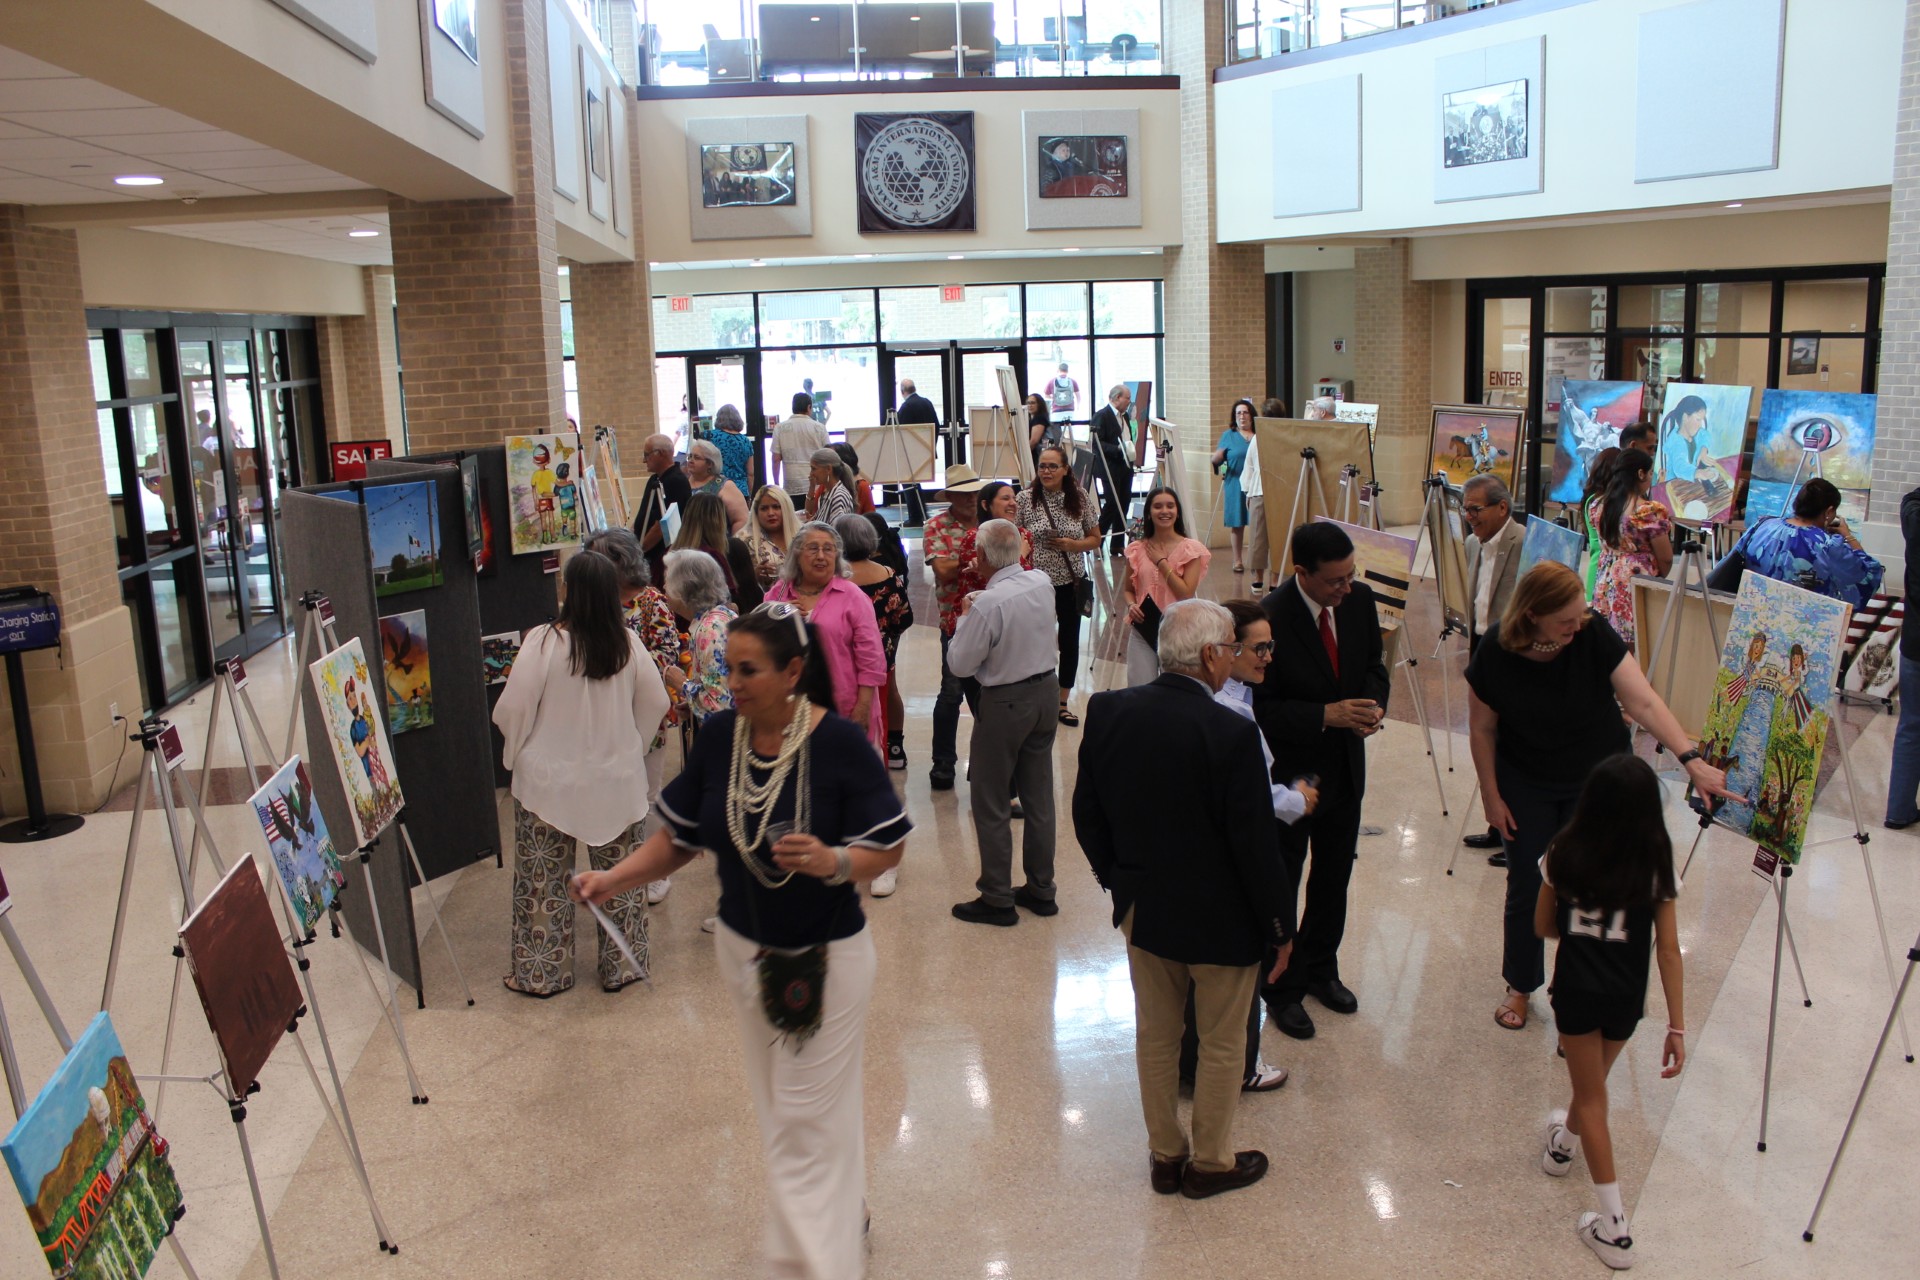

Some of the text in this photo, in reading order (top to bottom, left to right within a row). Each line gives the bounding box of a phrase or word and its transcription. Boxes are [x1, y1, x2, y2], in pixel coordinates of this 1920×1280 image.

[871, 126, 961, 213] TEXAS A&M INTERNATIONAL UNIVERSITY
[944, 287, 961, 301] EXIT
[672, 297, 689, 311] EXIT
[1489, 371, 1523, 387] ENTER
[336, 447, 385, 465] SAE
[30, 610, 56, 624] Station
